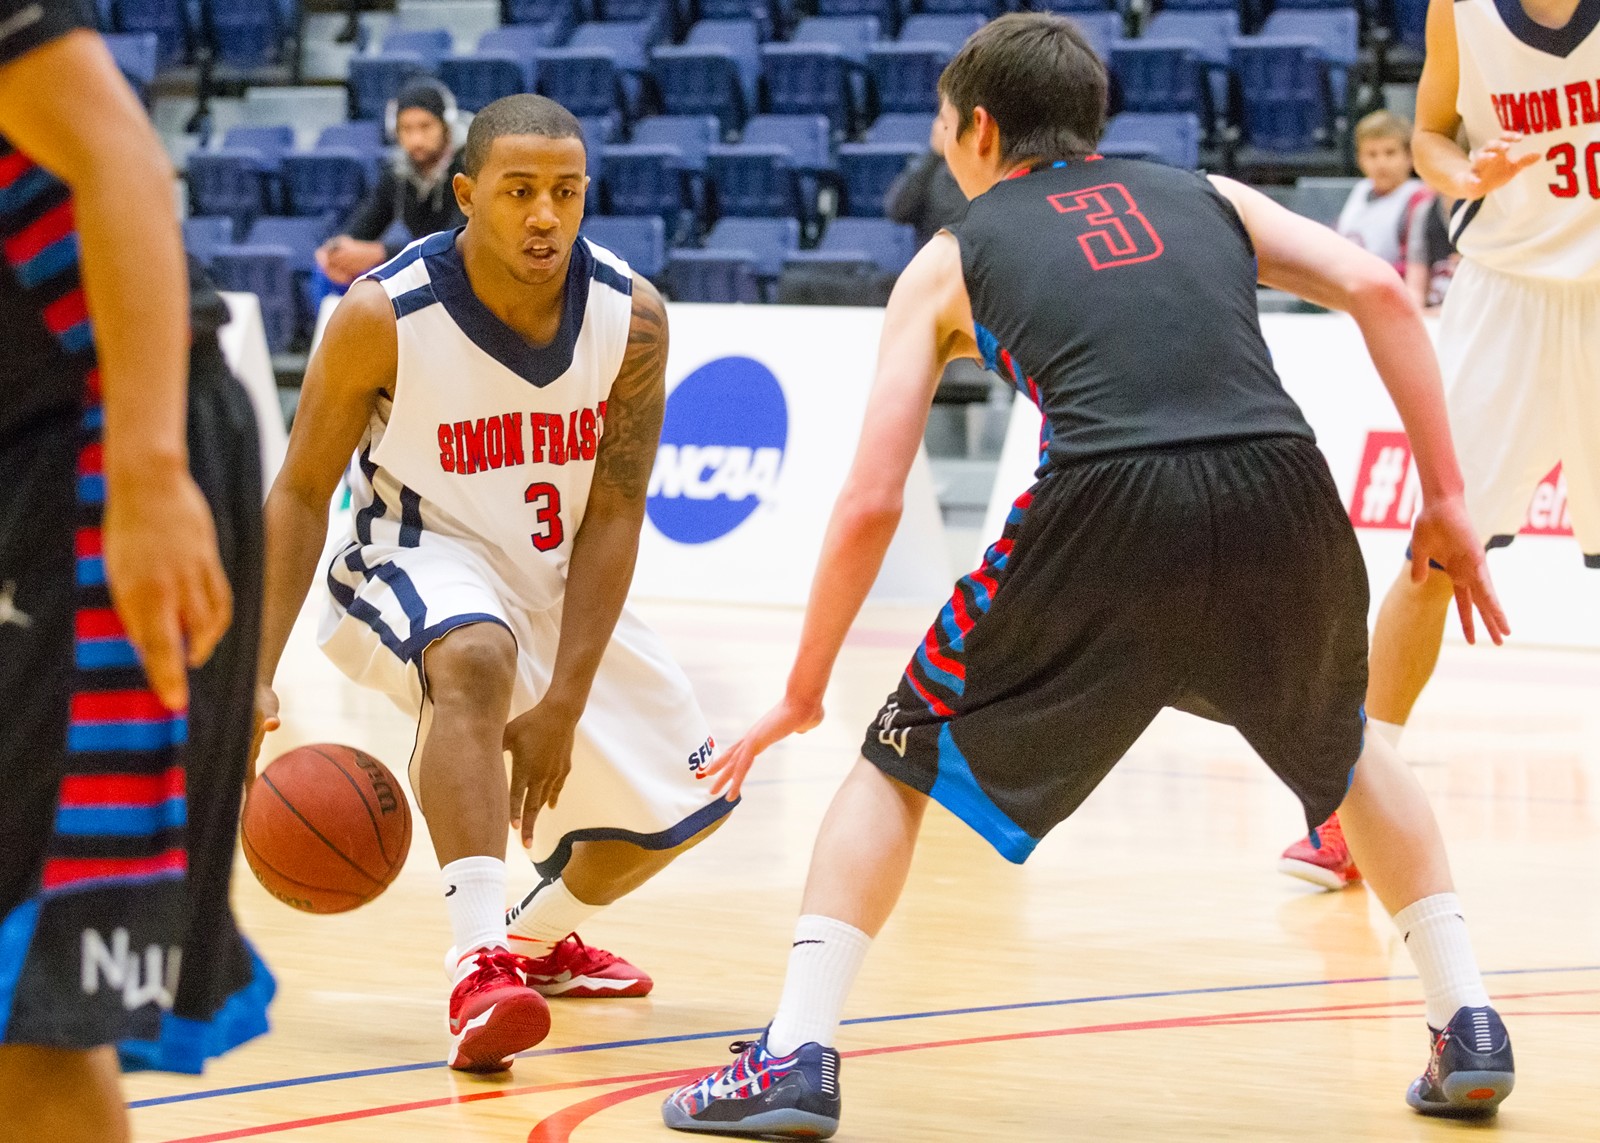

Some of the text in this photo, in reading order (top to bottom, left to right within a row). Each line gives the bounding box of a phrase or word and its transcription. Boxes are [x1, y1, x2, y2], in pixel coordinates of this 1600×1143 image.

[1046, 182, 1165, 271] 3
[438, 400, 607, 475] SIMON FRAS
[648, 442, 784, 502] NCAA
[524, 481, 564, 552] 3
[81, 926, 182, 1011] NW
